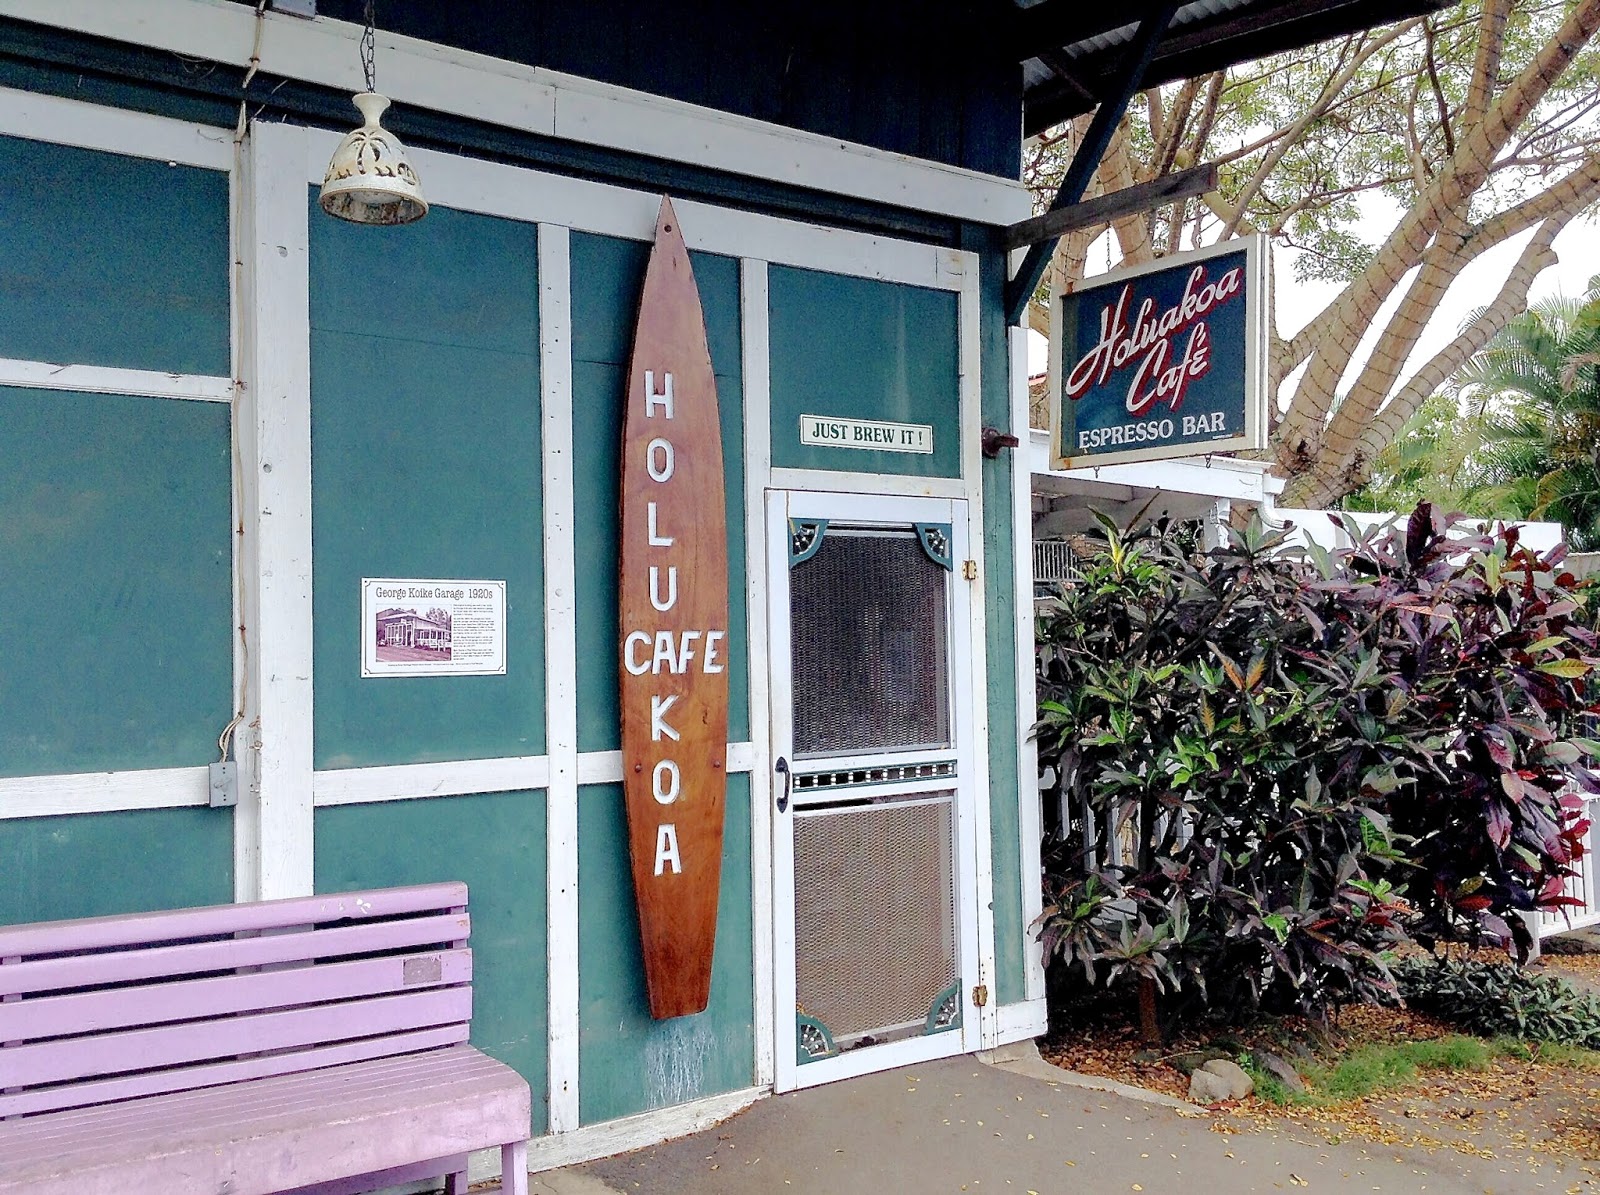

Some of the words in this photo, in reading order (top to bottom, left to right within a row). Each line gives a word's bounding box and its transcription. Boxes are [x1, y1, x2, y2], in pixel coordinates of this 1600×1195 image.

[1066, 265, 1242, 397] Holuakoa
[812, 422, 848, 439] JUST
[853, 426, 895, 443] BREW
[1079, 420, 1173, 449] ESPRESSO
[1182, 412, 1225, 436] BAR
[376, 587, 407, 600] George
[408, 588, 432, 598] Koike
[435, 588, 464, 600] Garage
[468, 588, 493, 599] 1920s
[624, 630, 725, 676] CAFE
